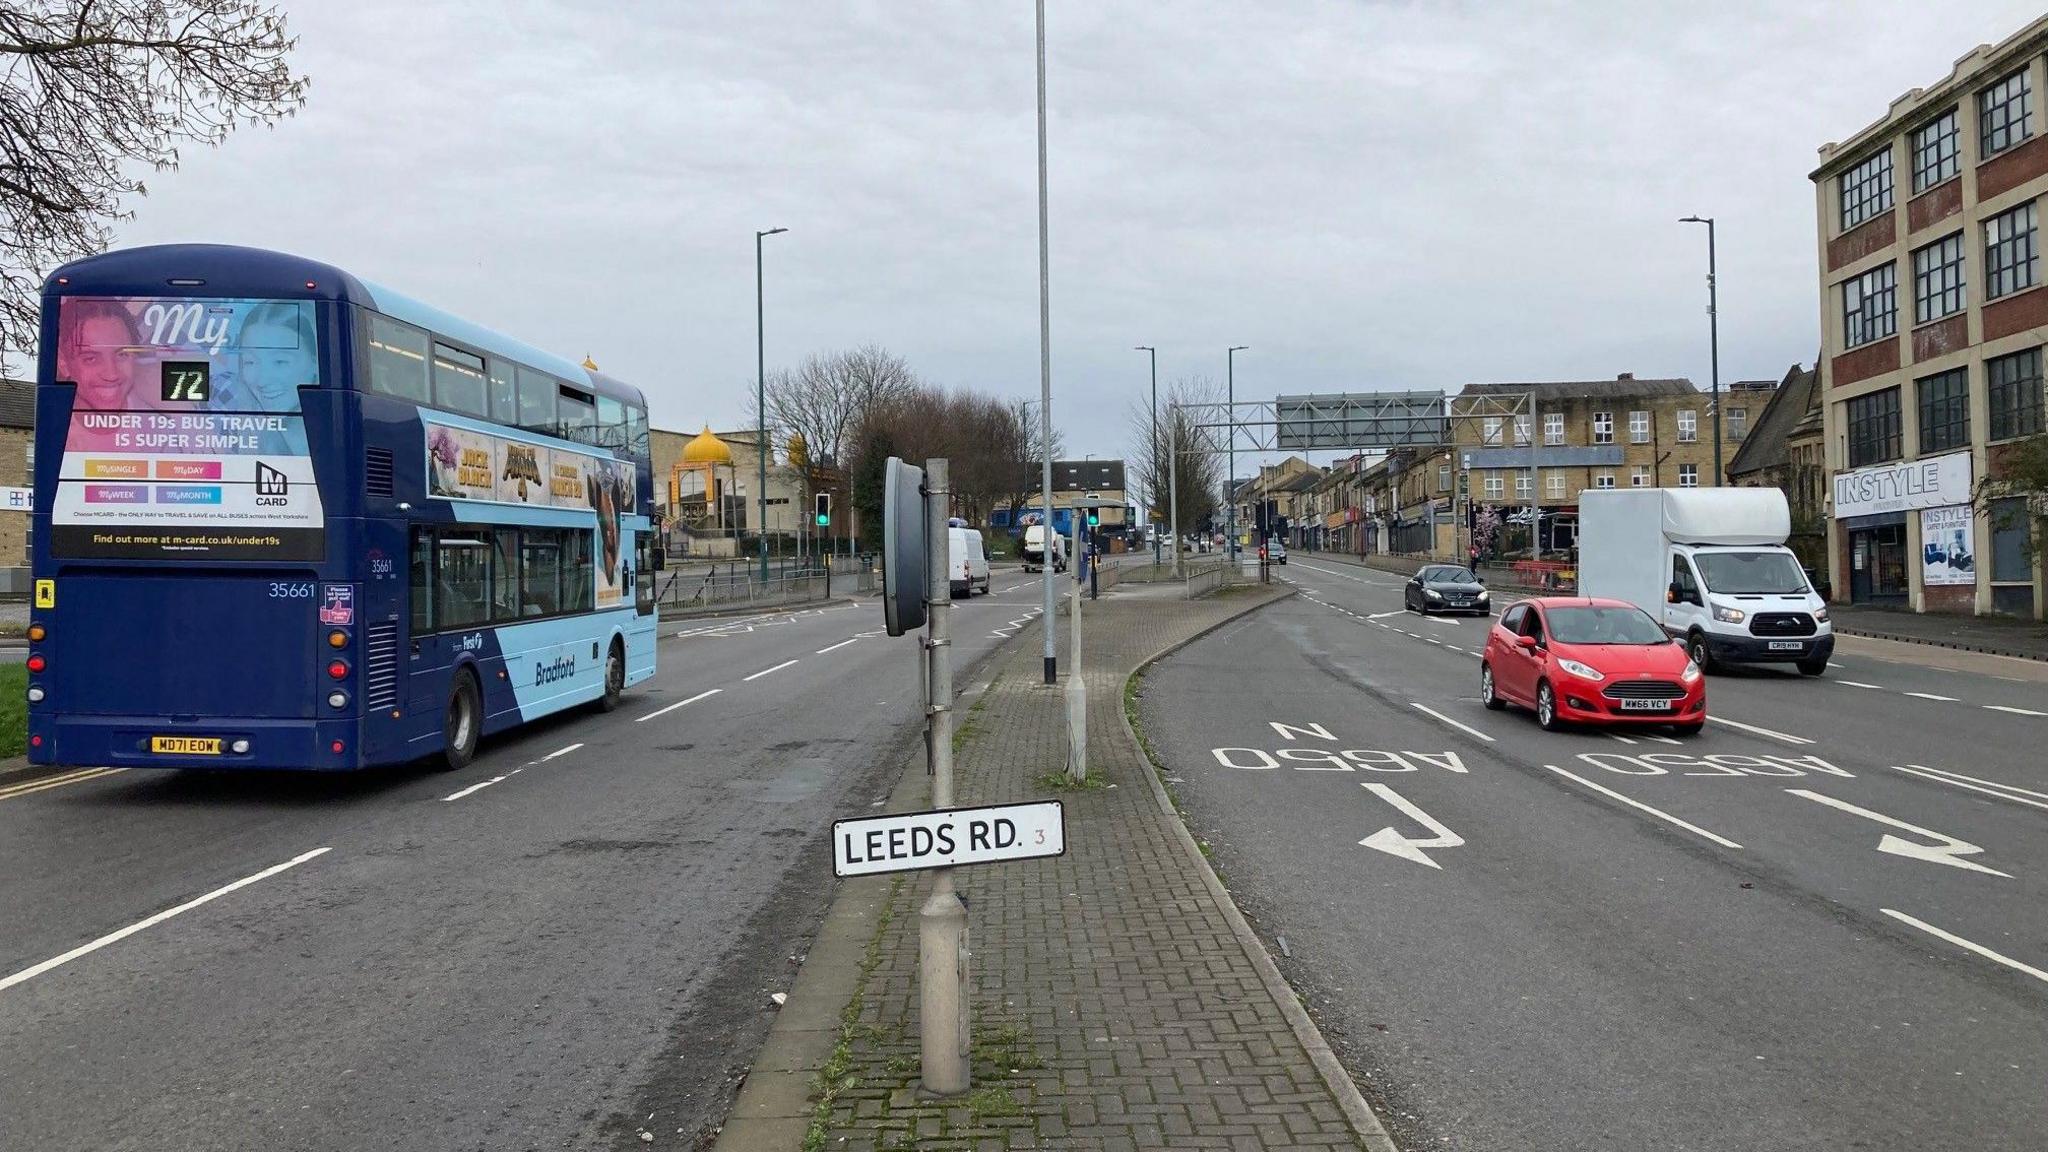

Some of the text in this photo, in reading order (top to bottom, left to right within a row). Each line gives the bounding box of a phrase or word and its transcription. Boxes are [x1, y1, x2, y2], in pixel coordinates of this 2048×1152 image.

[144, 303, 230, 355] My
[170, 371, 203, 400] 72
[83, 414, 287, 431] UNDER 19s BUS TRAVEL
[115, 433, 258, 449] IS SUPER SIMPLE
[458, 467, 492, 489] BLACK
[1837, 463, 1939, 505] INSTYLE
[256, 497, 287, 506] CARD
[1924, 506, 1971, 523] INSTYLE
[94, 534, 112, 543] Find
[160, 536, 170, 544] at
[173, 535, 280, 546] m-card.co.uk/under19s
[372, 560, 392, 573] 35661
[269, 582, 315, 598] 35661
[535, 654, 575, 687] Bradford
[1650, 700, 1668, 708] VCY
[159, 739, 213, 752] MD71 EOW
[845, 818, 1046, 865] LEEDS RD. 3
